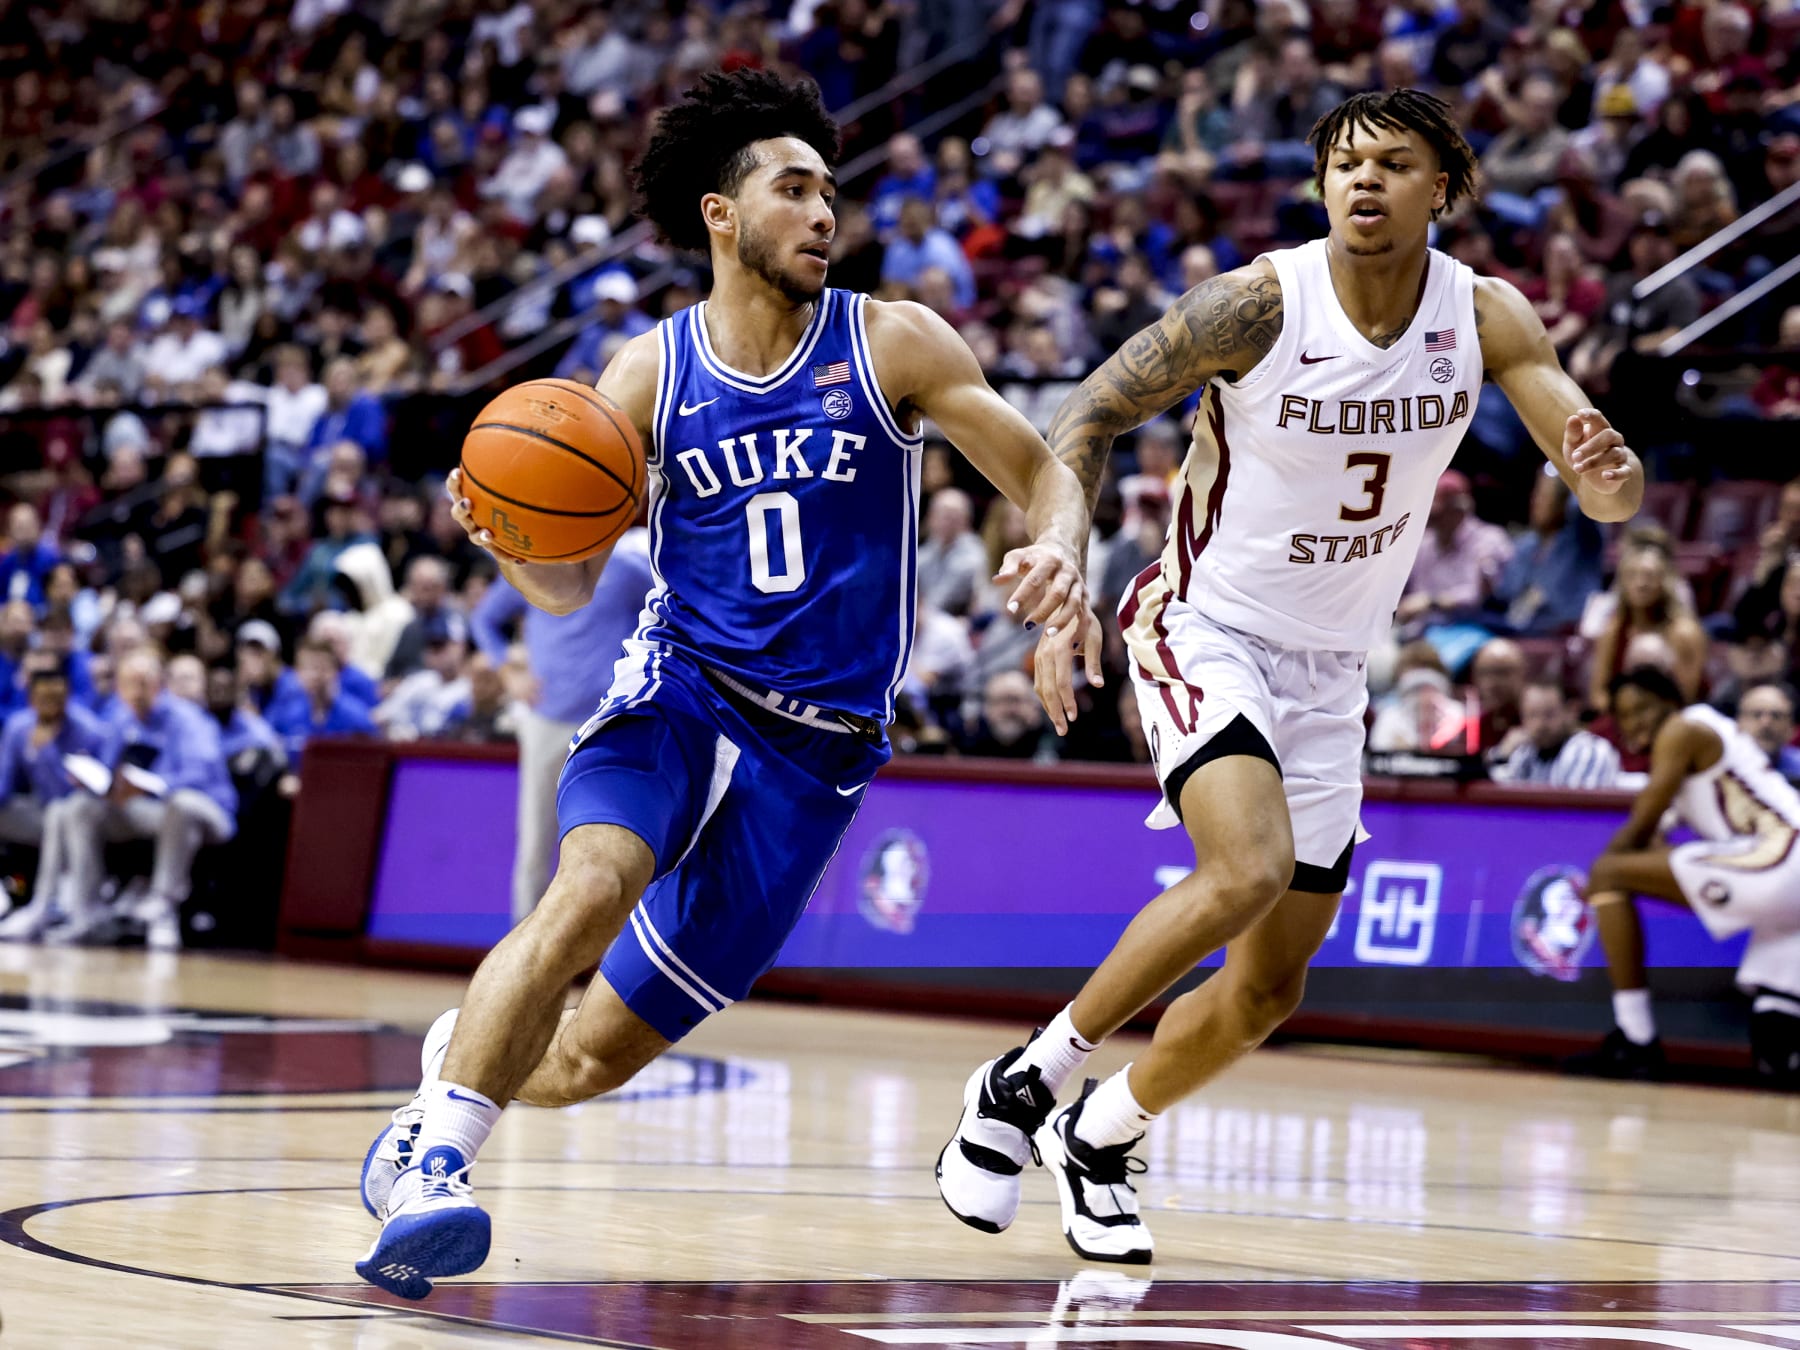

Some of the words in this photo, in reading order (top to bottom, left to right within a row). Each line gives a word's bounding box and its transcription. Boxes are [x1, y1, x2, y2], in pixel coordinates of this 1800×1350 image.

[1276, 390, 1470, 435] FLORIDA
[676, 428, 867, 498] DUKE
[1338, 452, 1393, 522] 3
[746, 491, 806, 594] 0
[1288, 511, 1412, 564] STATE
